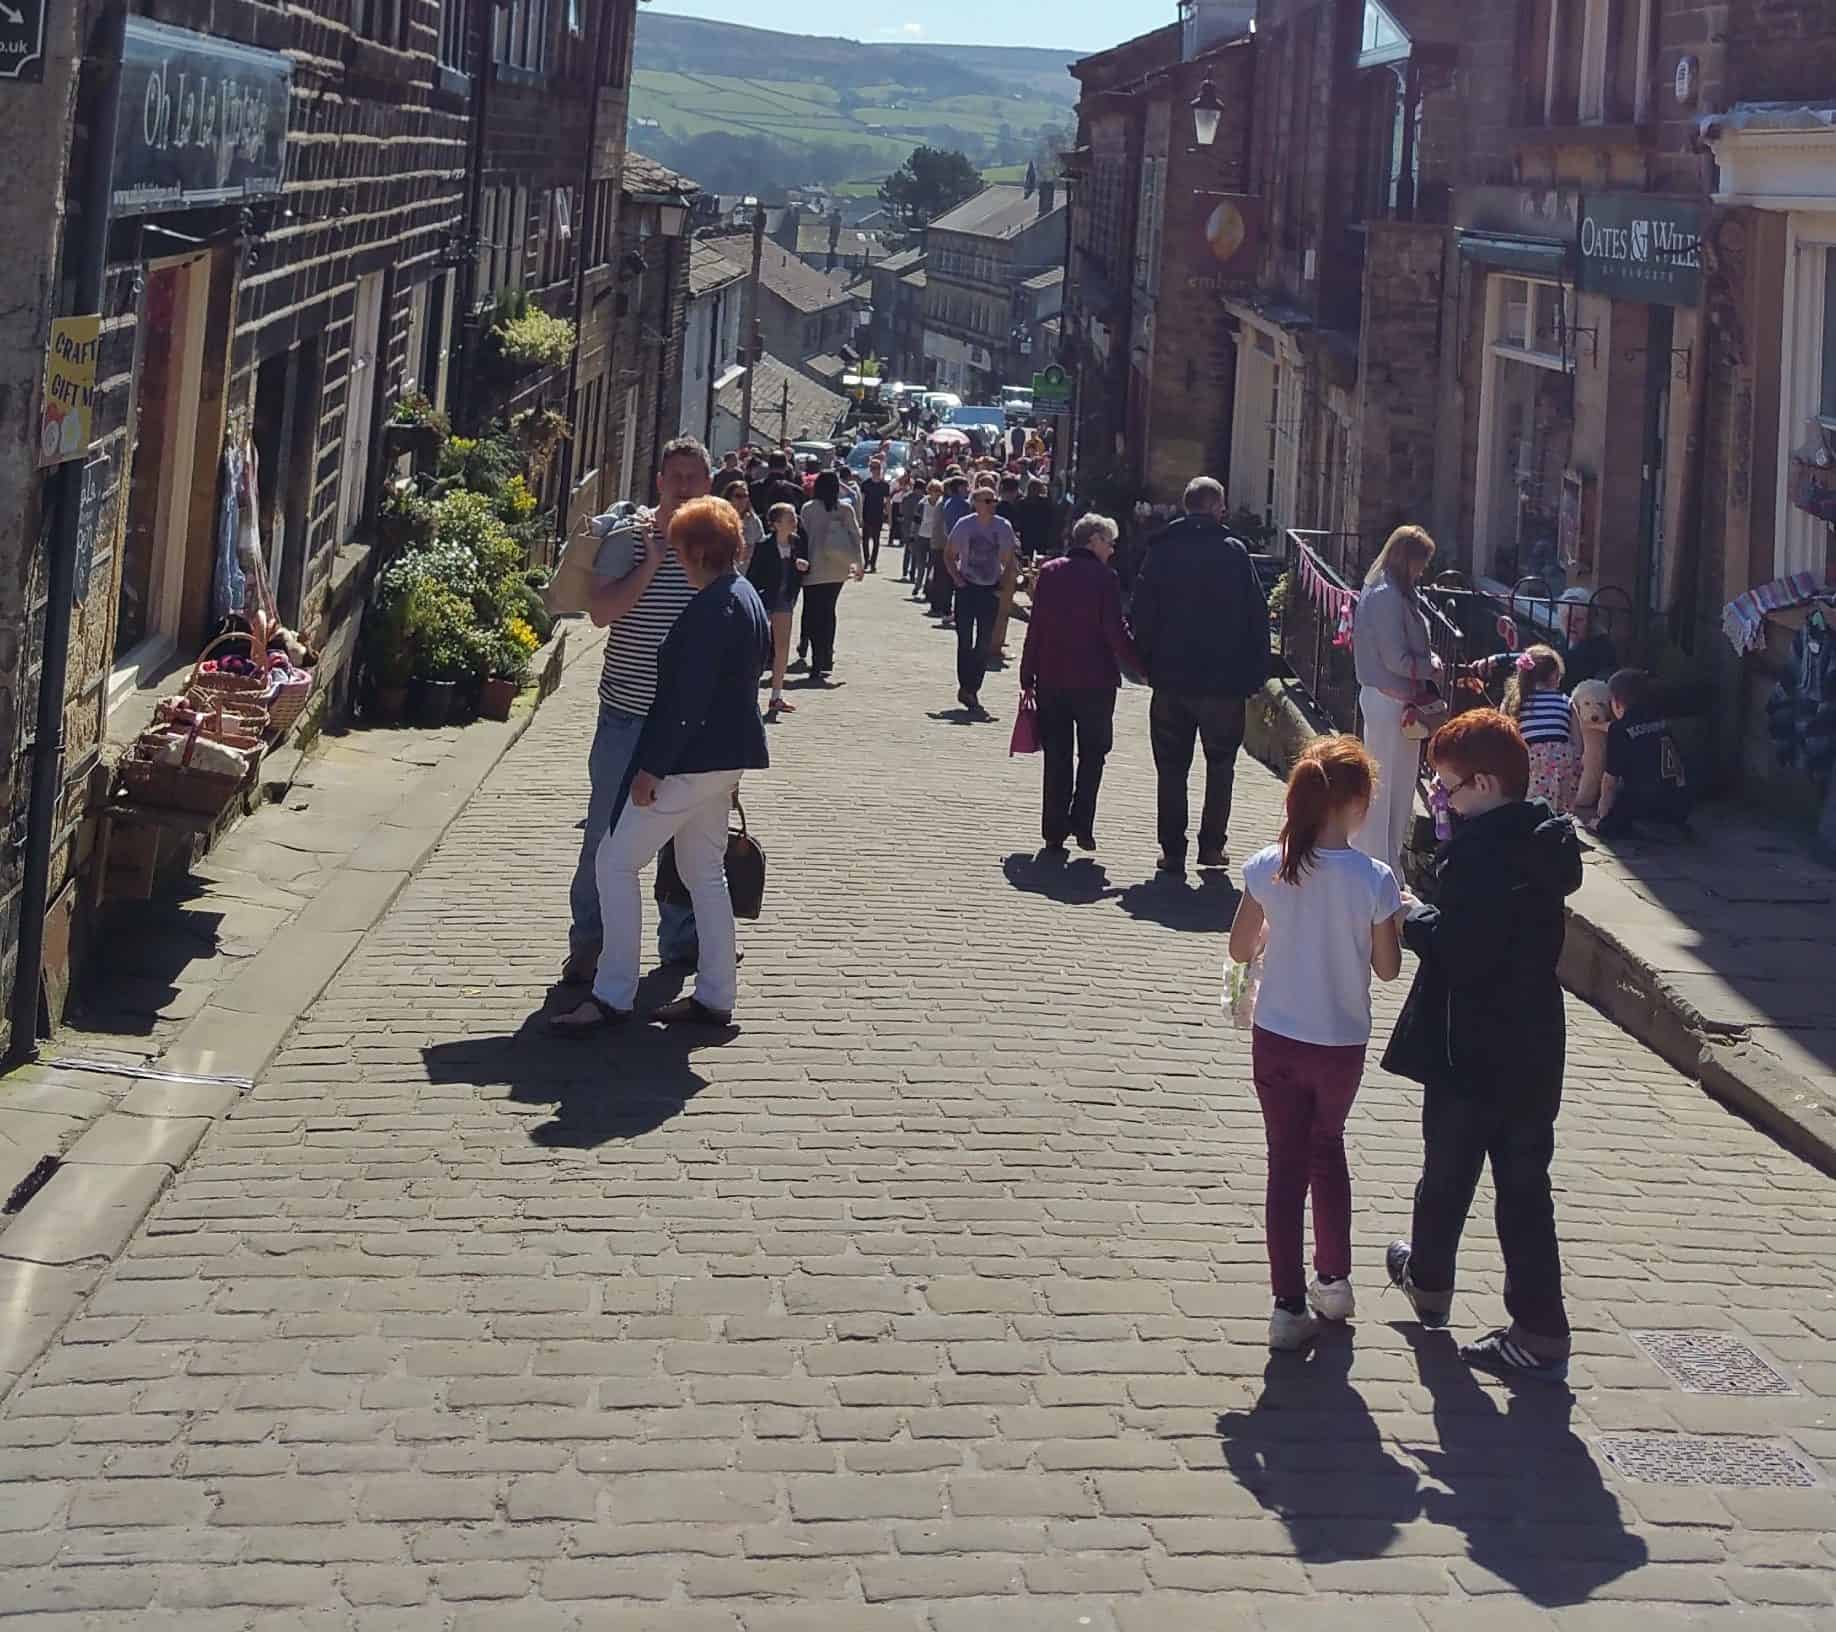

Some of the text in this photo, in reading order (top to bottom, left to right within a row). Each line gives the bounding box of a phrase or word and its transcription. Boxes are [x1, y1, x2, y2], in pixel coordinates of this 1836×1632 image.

[144, 59, 170, 151] Oh
[173, 73, 195, 148] La
[196, 76, 216, 148] La
